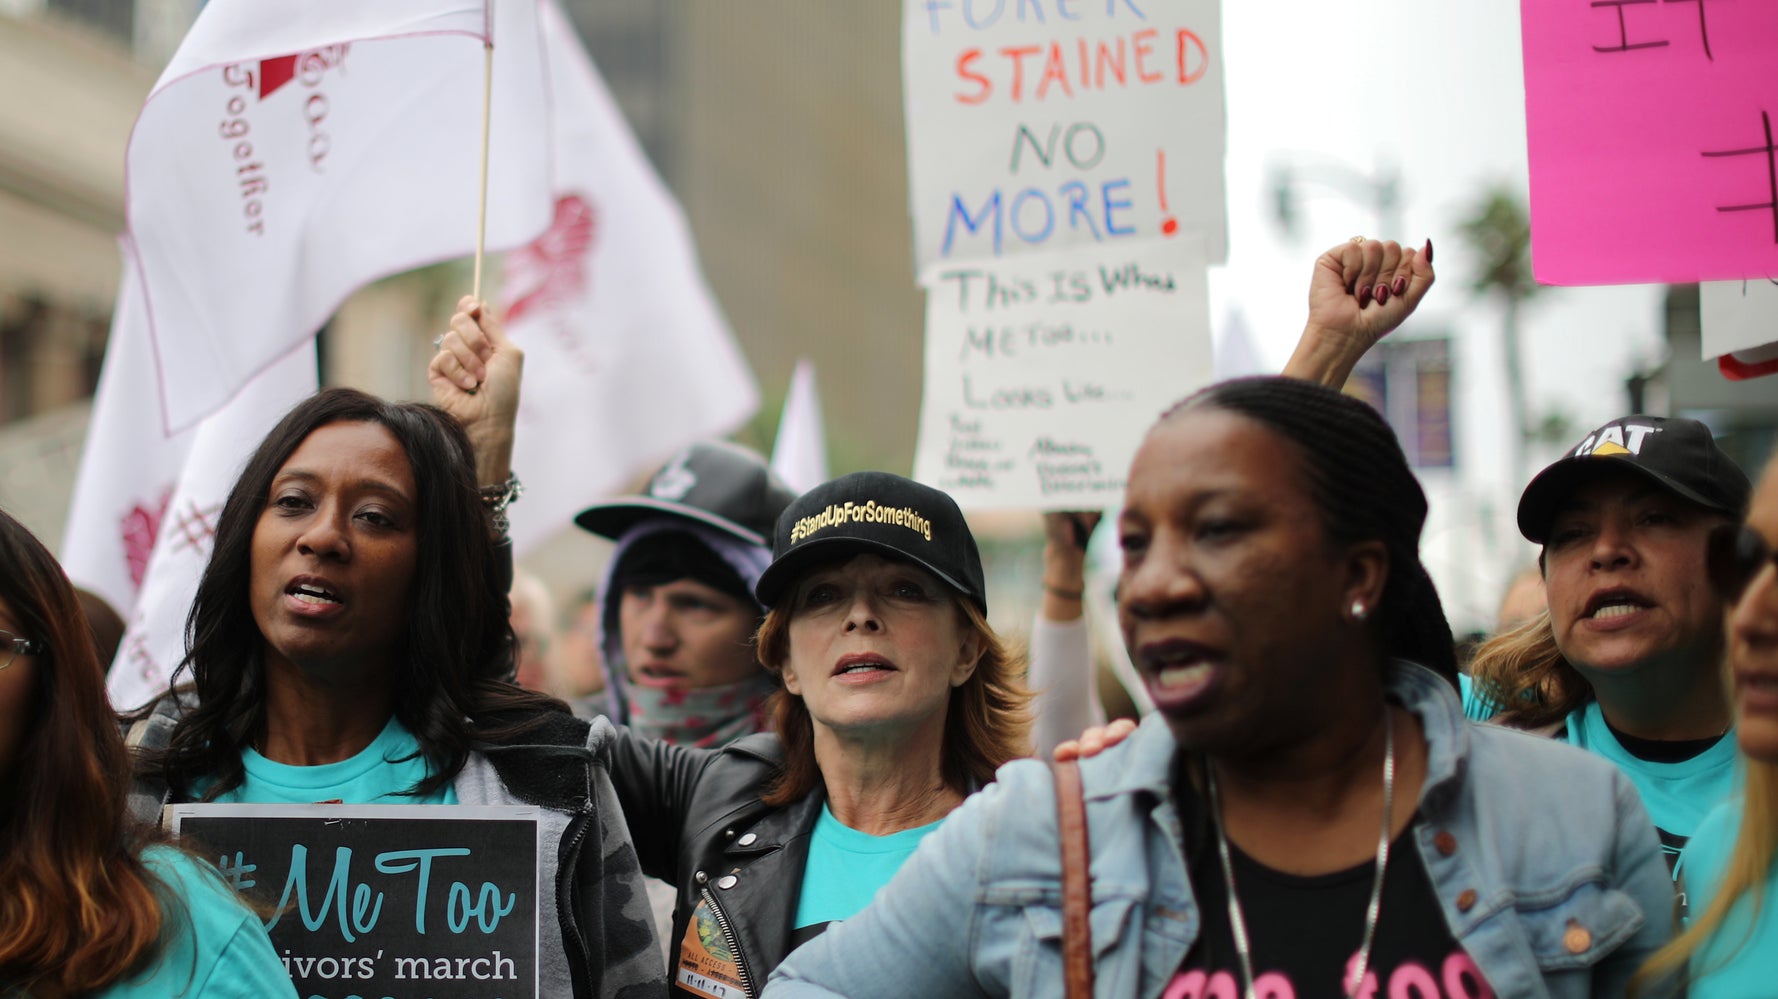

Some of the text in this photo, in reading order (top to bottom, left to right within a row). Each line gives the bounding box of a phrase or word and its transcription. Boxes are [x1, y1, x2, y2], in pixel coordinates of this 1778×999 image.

[953, 28, 1209, 104] STAINED
[1009, 121, 1106, 174] NO
[1575, 424, 1656, 457] CAT
[790, 500, 932, 544] #StandUpForSomething
[395, 950, 518, 981] march
[687, 951, 726, 971] ALL ACCESS
